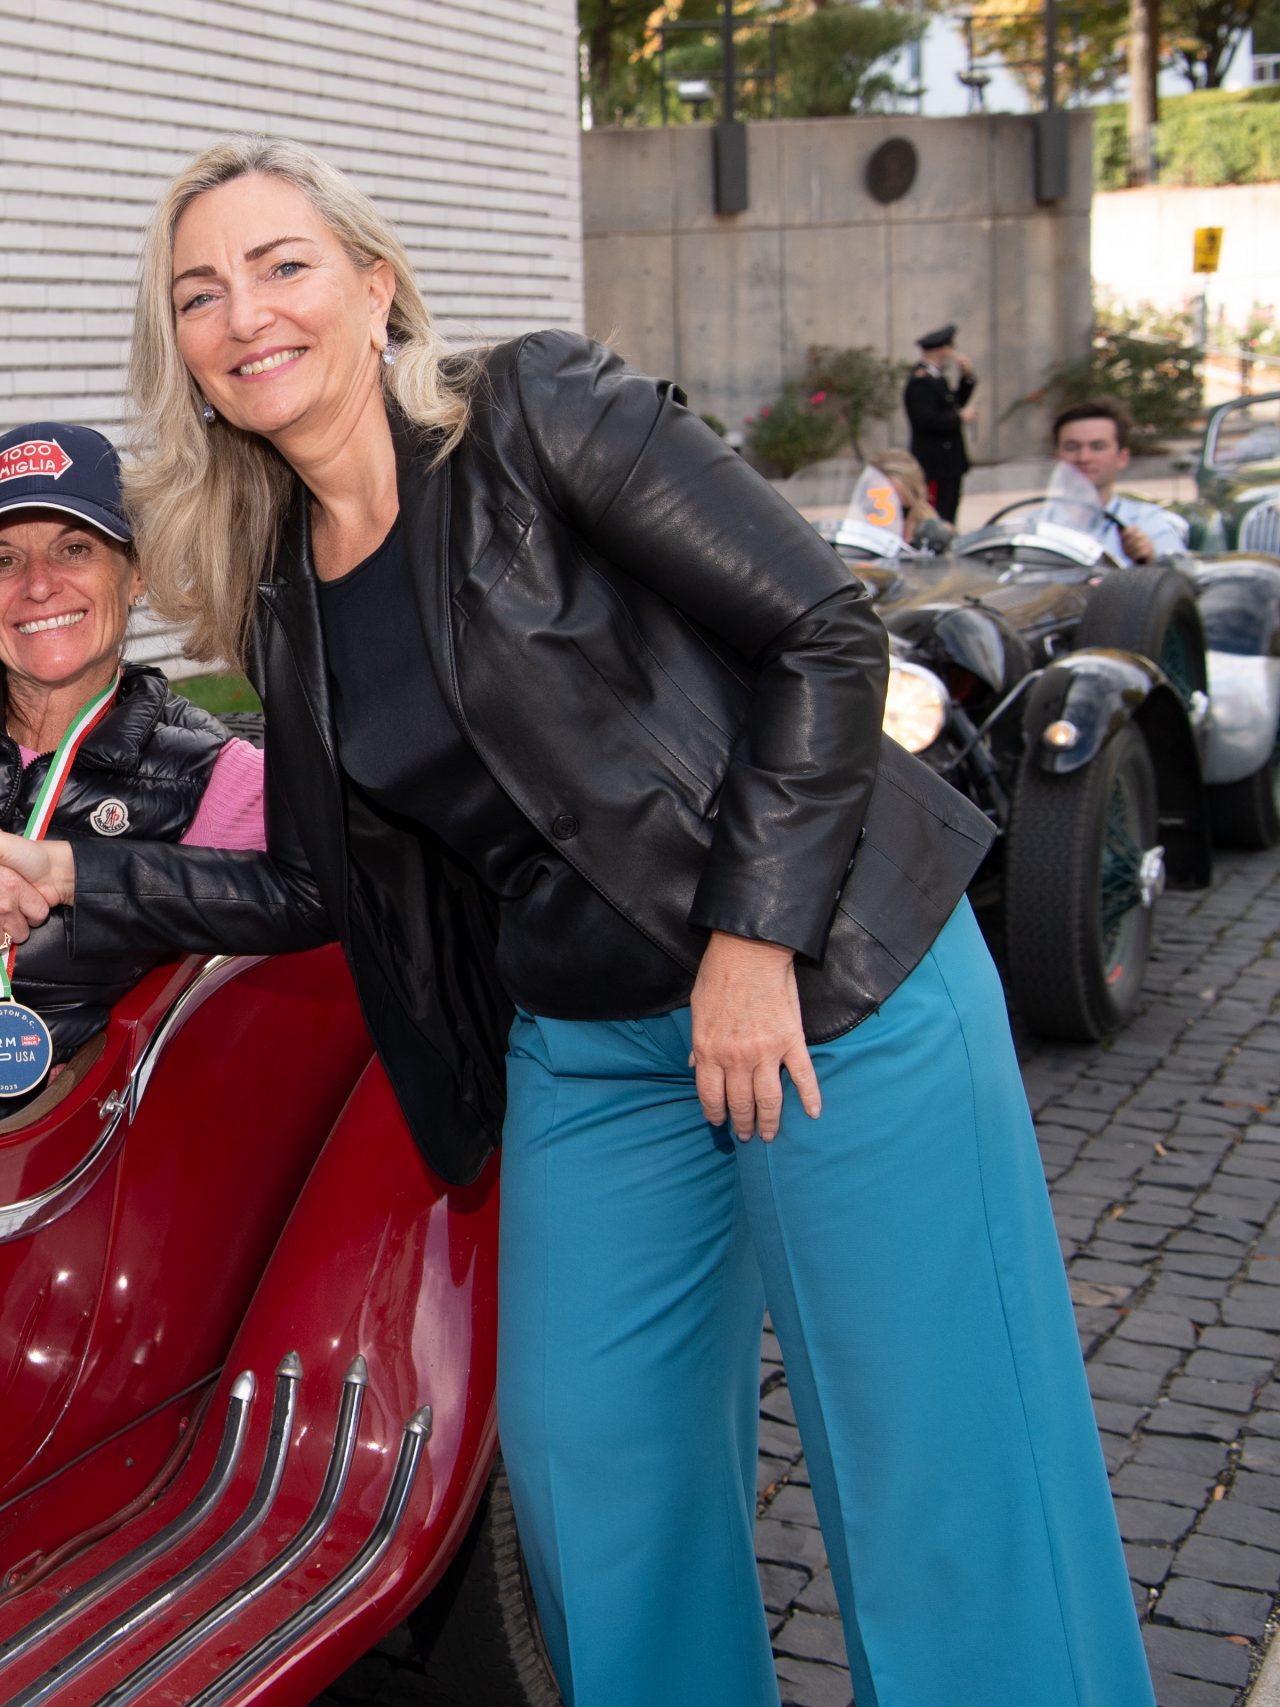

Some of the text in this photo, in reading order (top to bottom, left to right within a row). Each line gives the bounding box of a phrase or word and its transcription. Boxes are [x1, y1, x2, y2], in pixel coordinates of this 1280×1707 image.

[2, 444, 52, 463] 1000
[866, 486, 897, 527] 3
[15, 1050, 36, 1062] USA
